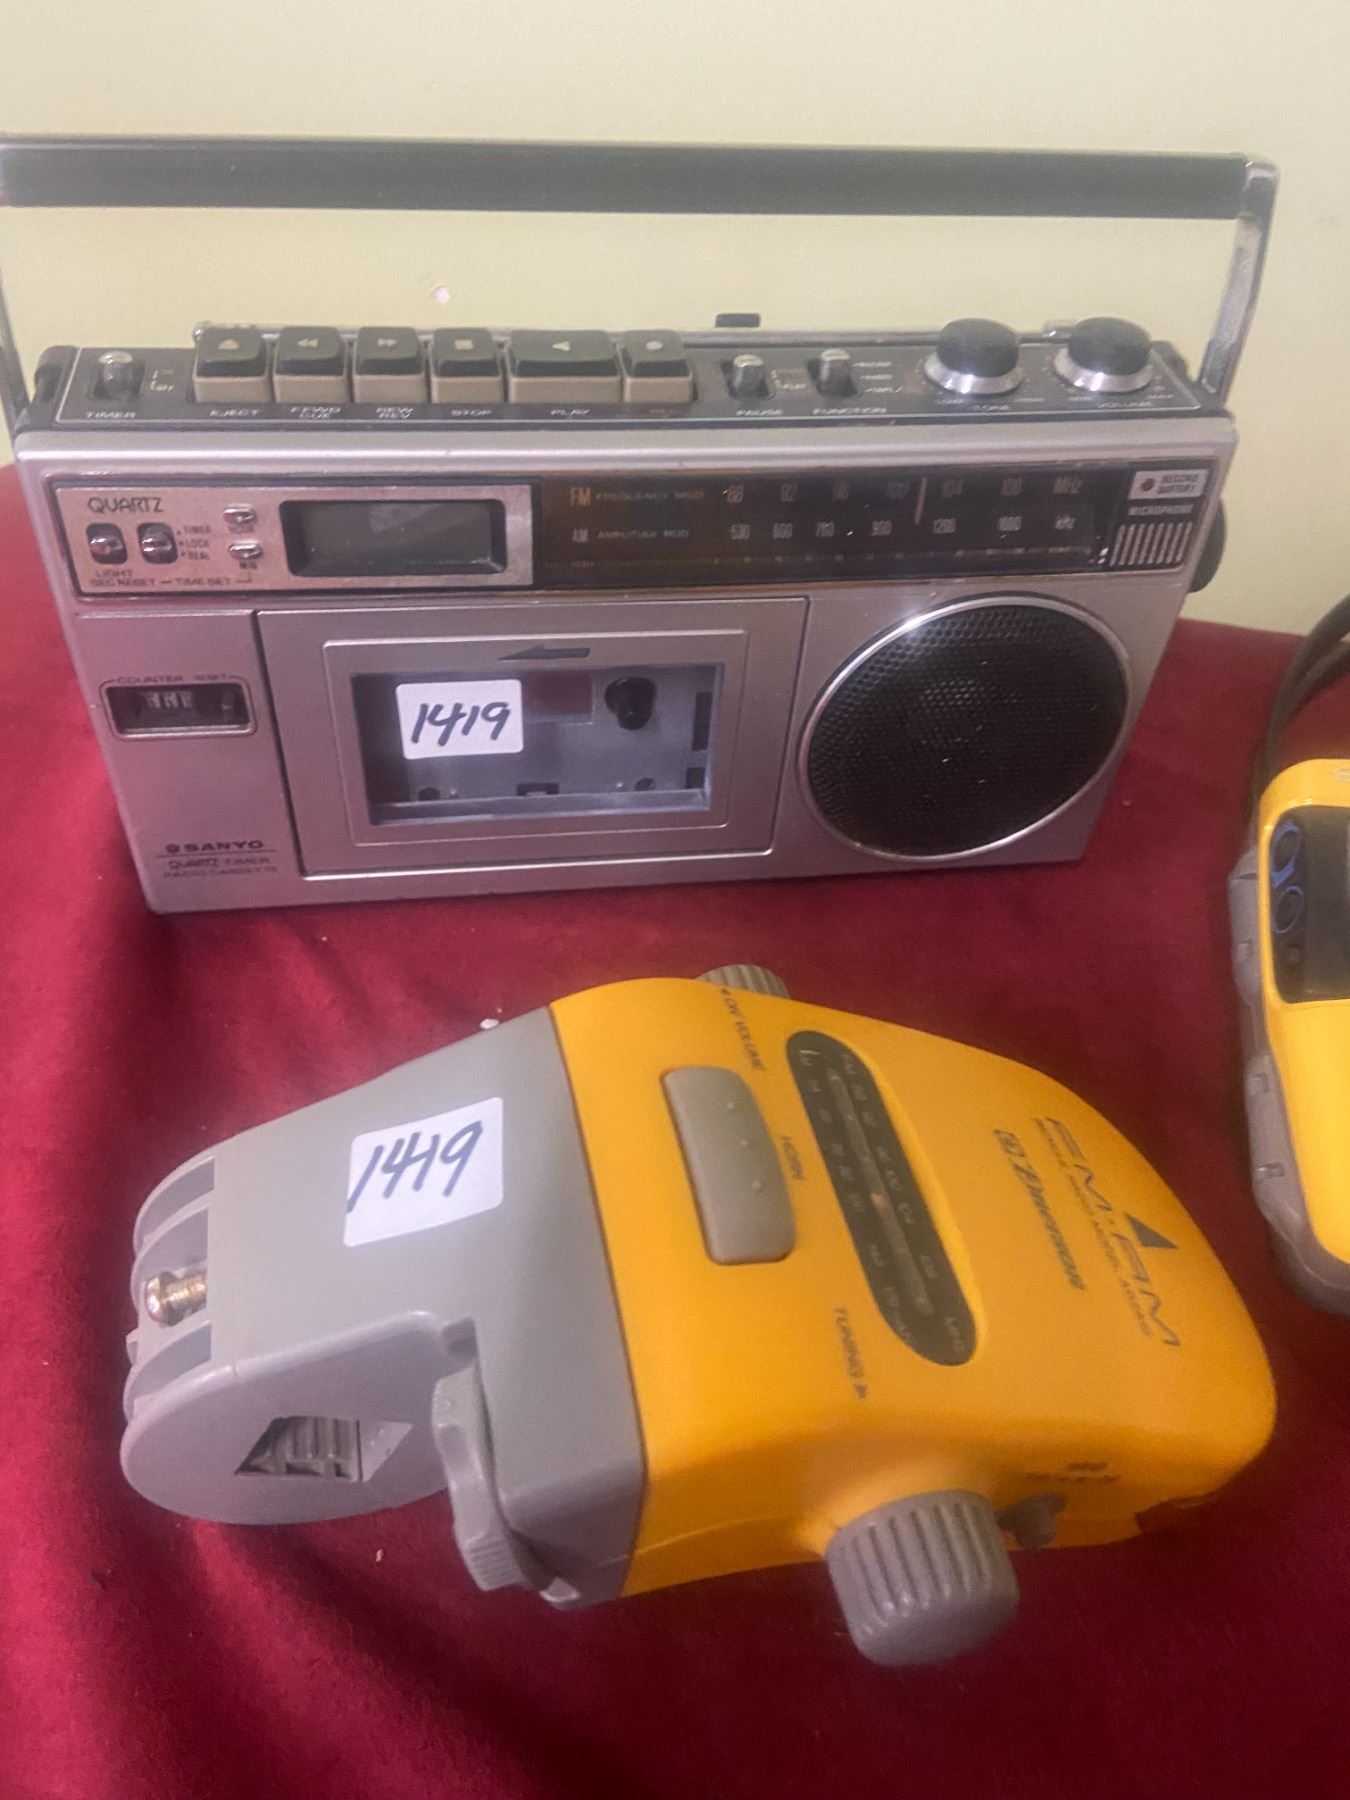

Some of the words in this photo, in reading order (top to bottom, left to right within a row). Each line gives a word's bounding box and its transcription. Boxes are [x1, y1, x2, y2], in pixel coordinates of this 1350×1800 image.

[86, 411, 135, 419] TIMER
[209, 409, 260, 417] EJECT
[451, 409, 493, 417] STOP
[550, 409, 590, 417] PLAY
[570, 486, 591, 506] FM
[727, 485, 744, 503] 88
[87, 497, 164, 514] QUARTZ
[572, 527, 589, 543] AM
[95, 569, 133, 578] LIGHT
[118, 675, 184, 684] COUNTER
[410, 700, 511, 747] 1419
[184, 840, 263, 853] SANYO
